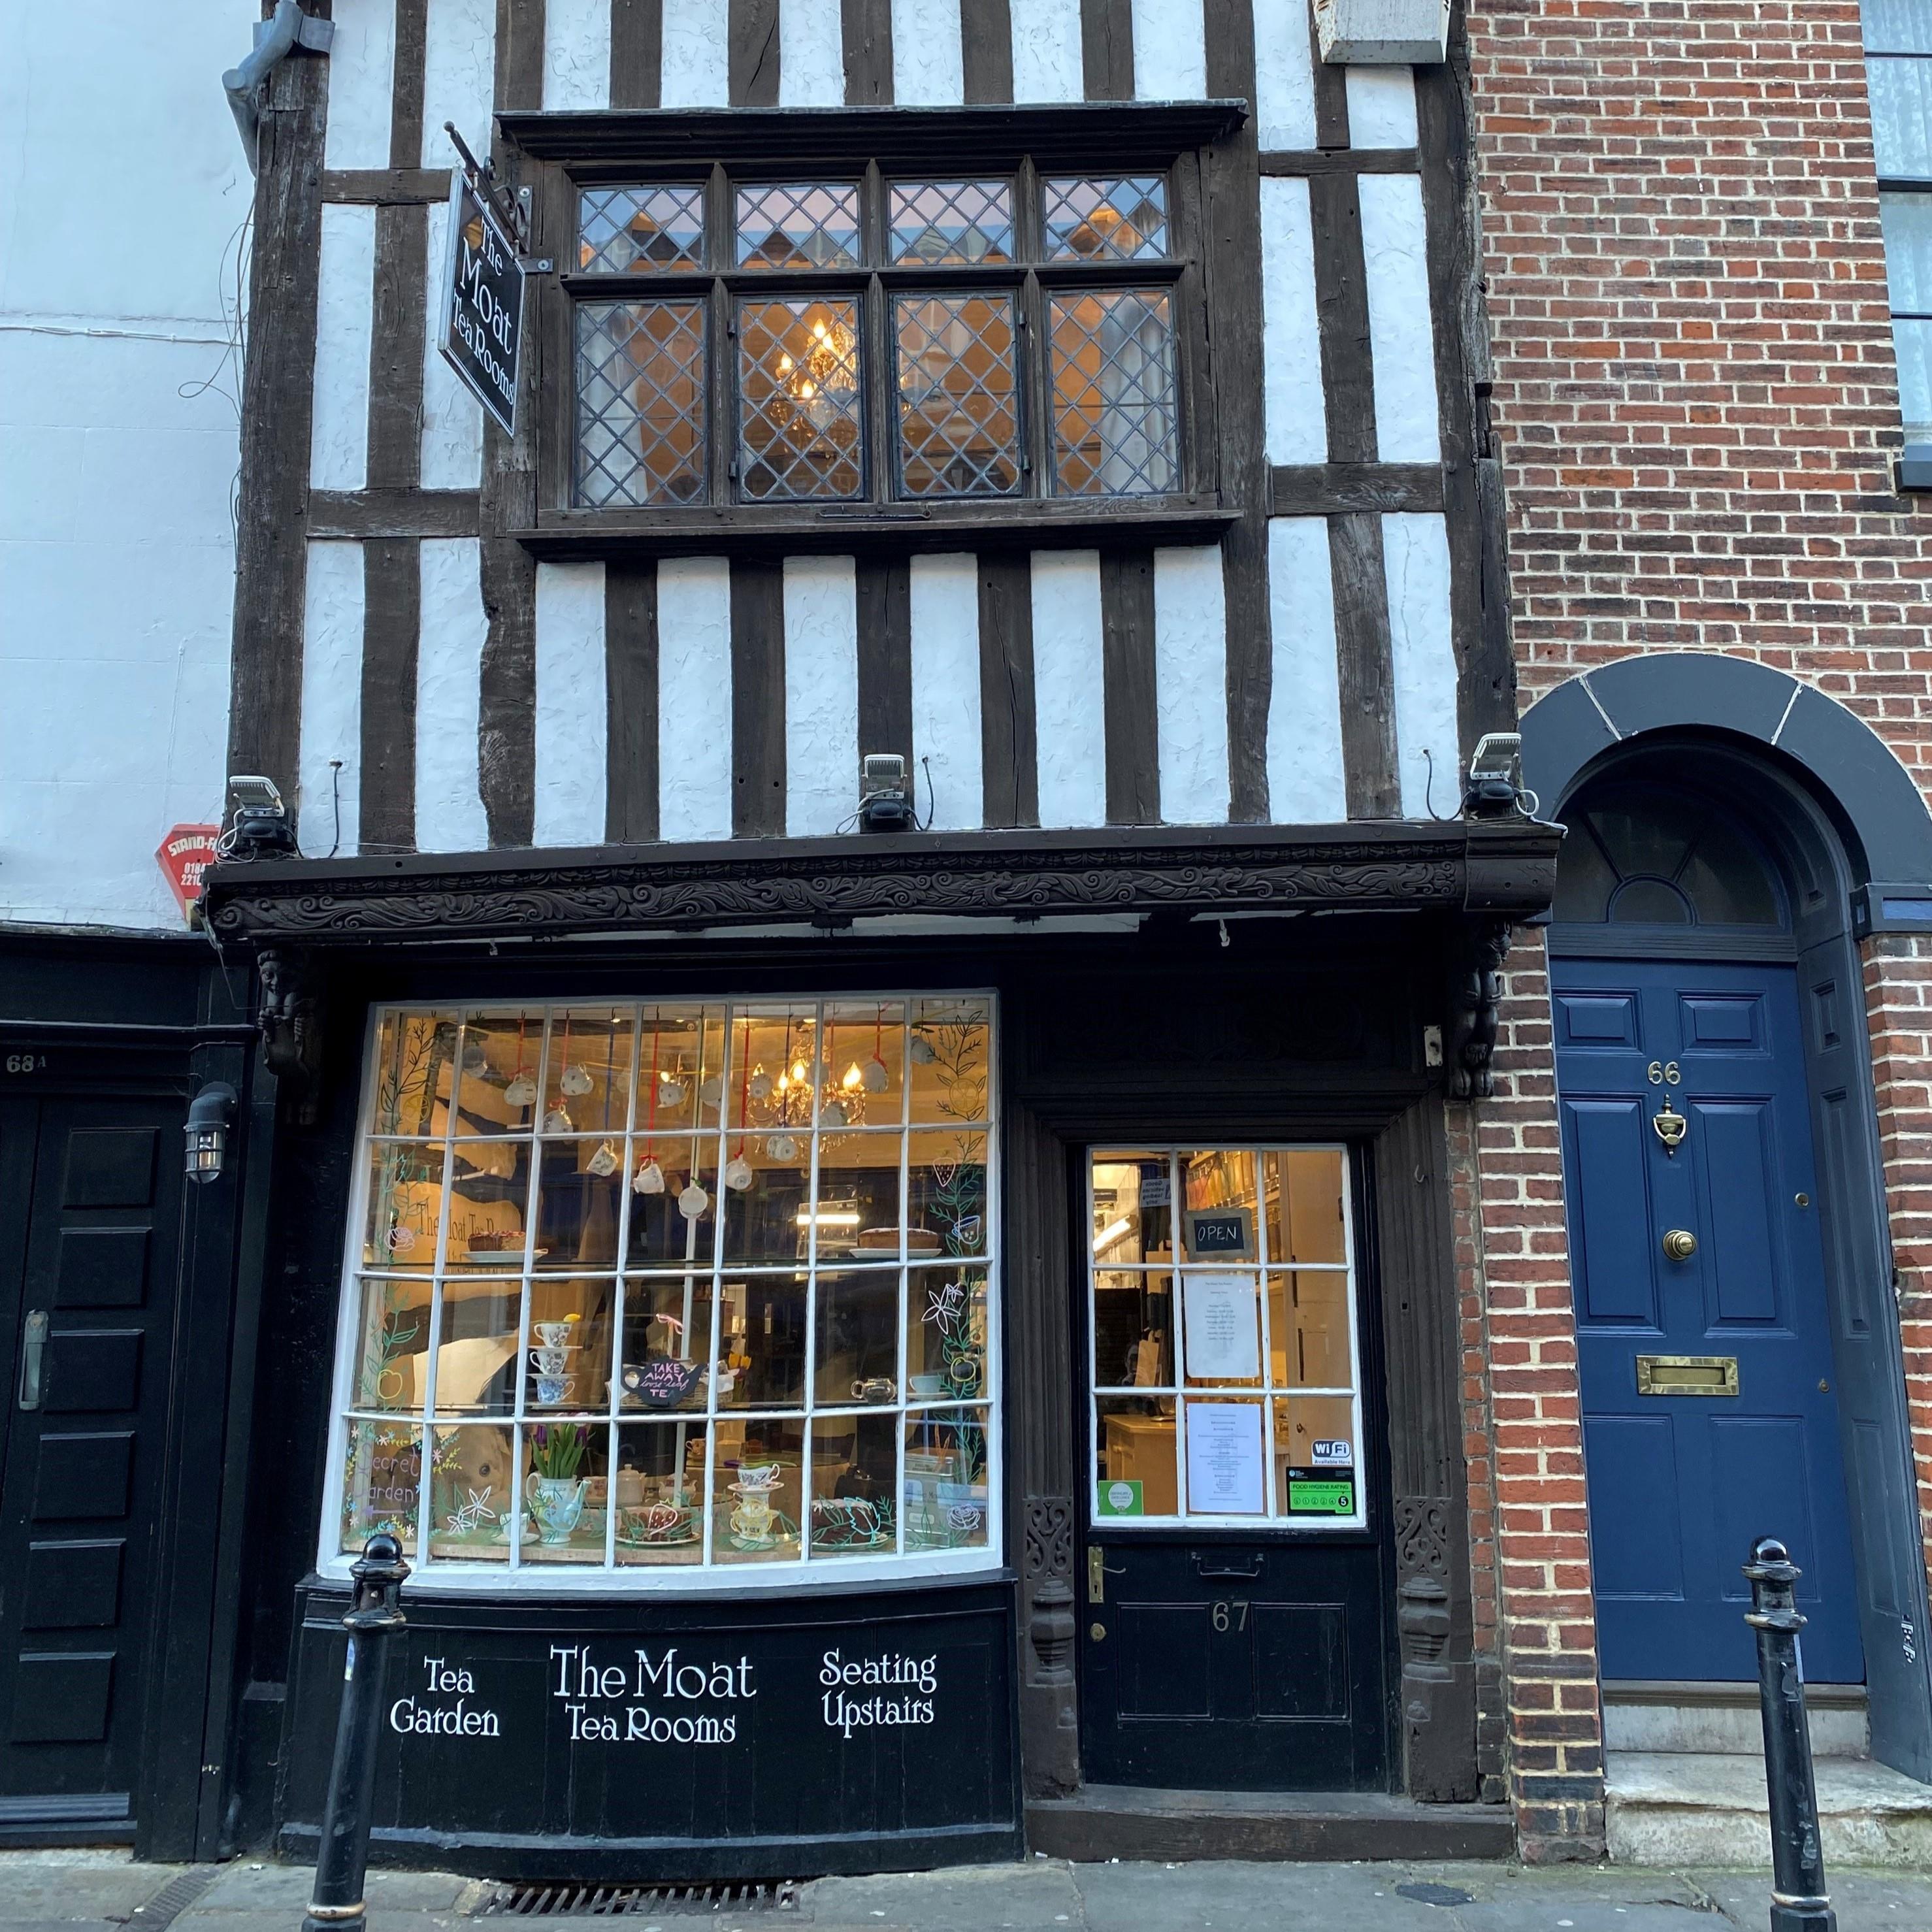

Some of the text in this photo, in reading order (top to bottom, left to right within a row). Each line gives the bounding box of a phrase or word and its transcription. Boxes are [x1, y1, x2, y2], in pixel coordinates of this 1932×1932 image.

[481, 215, 503, 276] The
[460, 237, 512, 355] Moat
[453, 288, 515, 406] Tea Rooms
[184, 862, 212, 874] 0184
[1647, 1061, 1681, 1085] 66
[449, 1209, 467, 1242] oat
[1198, 1226, 1236, 1241] OPEN
[644, 1372, 685, 1382] AWAY
[652, 1363, 680, 1373] TAKE
[357, 1443, 418, 1477] Secret
[1341, 1497, 1347, 1506] 5
[1213, 1602, 1249, 1631] 67
[424, 1655, 475, 1693] Tea
[551, 1645, 757, 1698] The Moat
[819, 1648, 937, 1694] Seating
[391, 1696, 500, 1736] Garden
[565, 1702, 736, 1743] Tea Rooms
[821, 1690, 934, 1739] Upstairs
